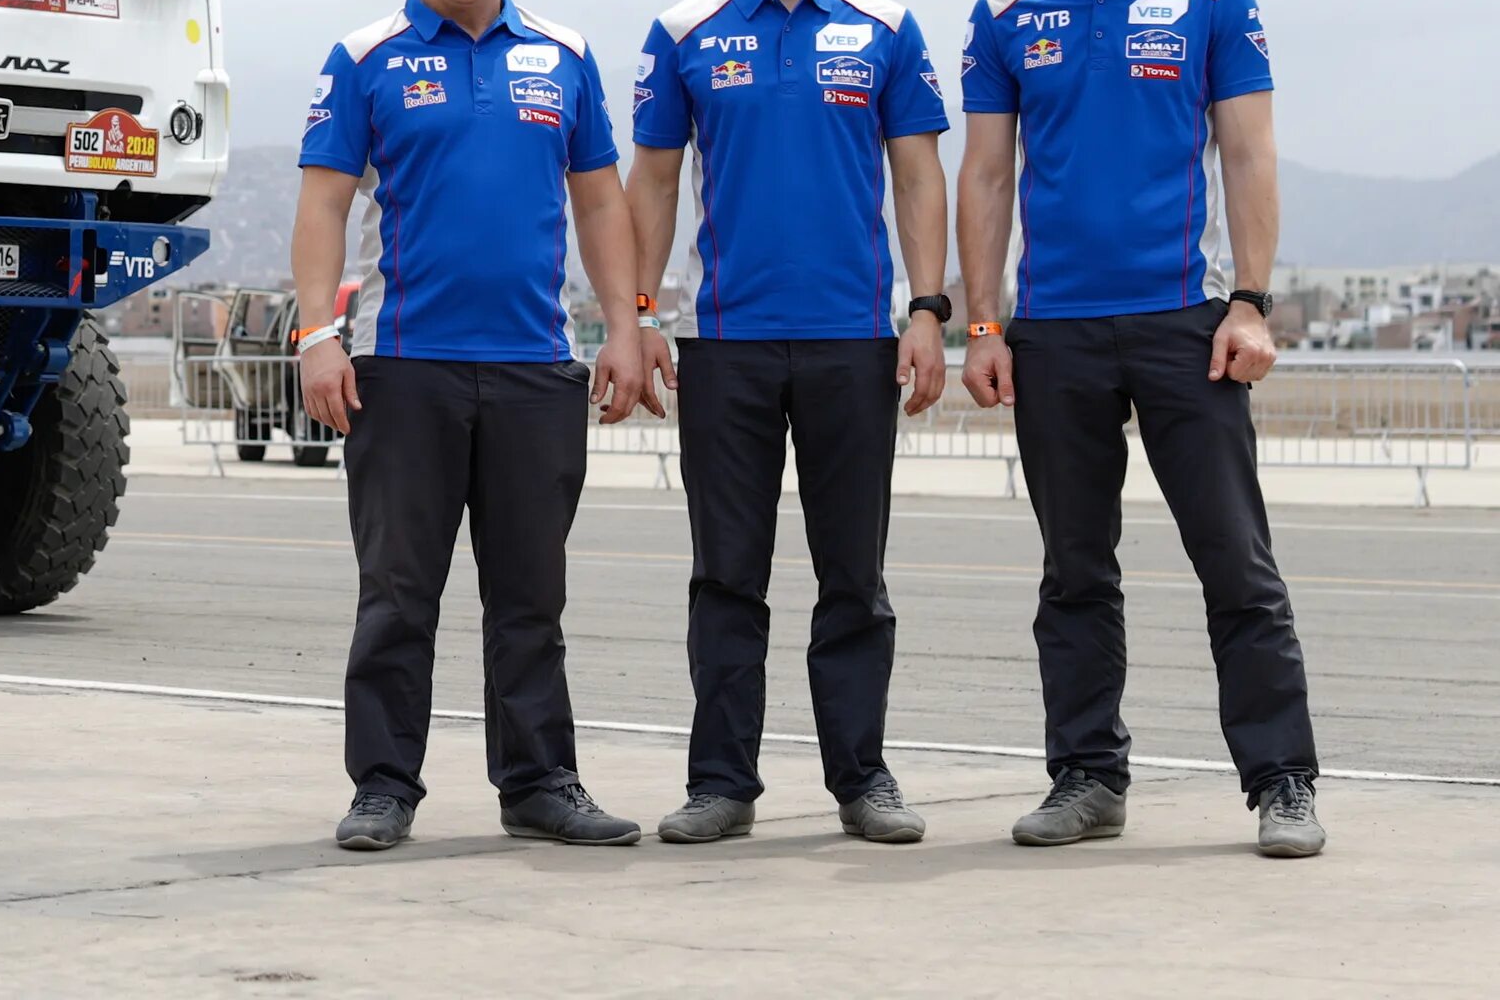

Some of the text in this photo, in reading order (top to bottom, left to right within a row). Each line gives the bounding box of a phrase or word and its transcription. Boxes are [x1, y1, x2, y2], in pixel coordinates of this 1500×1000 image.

[1137, 6, 1173, 18] VEB
[1033, 10, 1071, 31] VTB
[717, 35, 758, 53] VTB
[823, 34, 859, 46] VEB
[1131, 43, 1181, 51] KAMAZ
[405, 56, 447, 73] VTB
[513, 55, 548, 68] VEB
[1025, 51, 1062, 69] Red Bull
[822, 69, 869, 79] KAMAZ
[1145, 67, 1178, 77] TOTAL
[712, 73, 753, 89] Red Bull
[404, 92, 447, 109] Red Bull
[515, 88, 559, 100] KAMAZ
[836, 93, 867, 104] TOTAL
[531, 111, 560, 124] TOTAL
[74, 130, 156, 156] 502 2018
[69, 155, 154, 172] PERU BOLIVIA ARGENTINA
[124, 257, 154, 278] VTB
